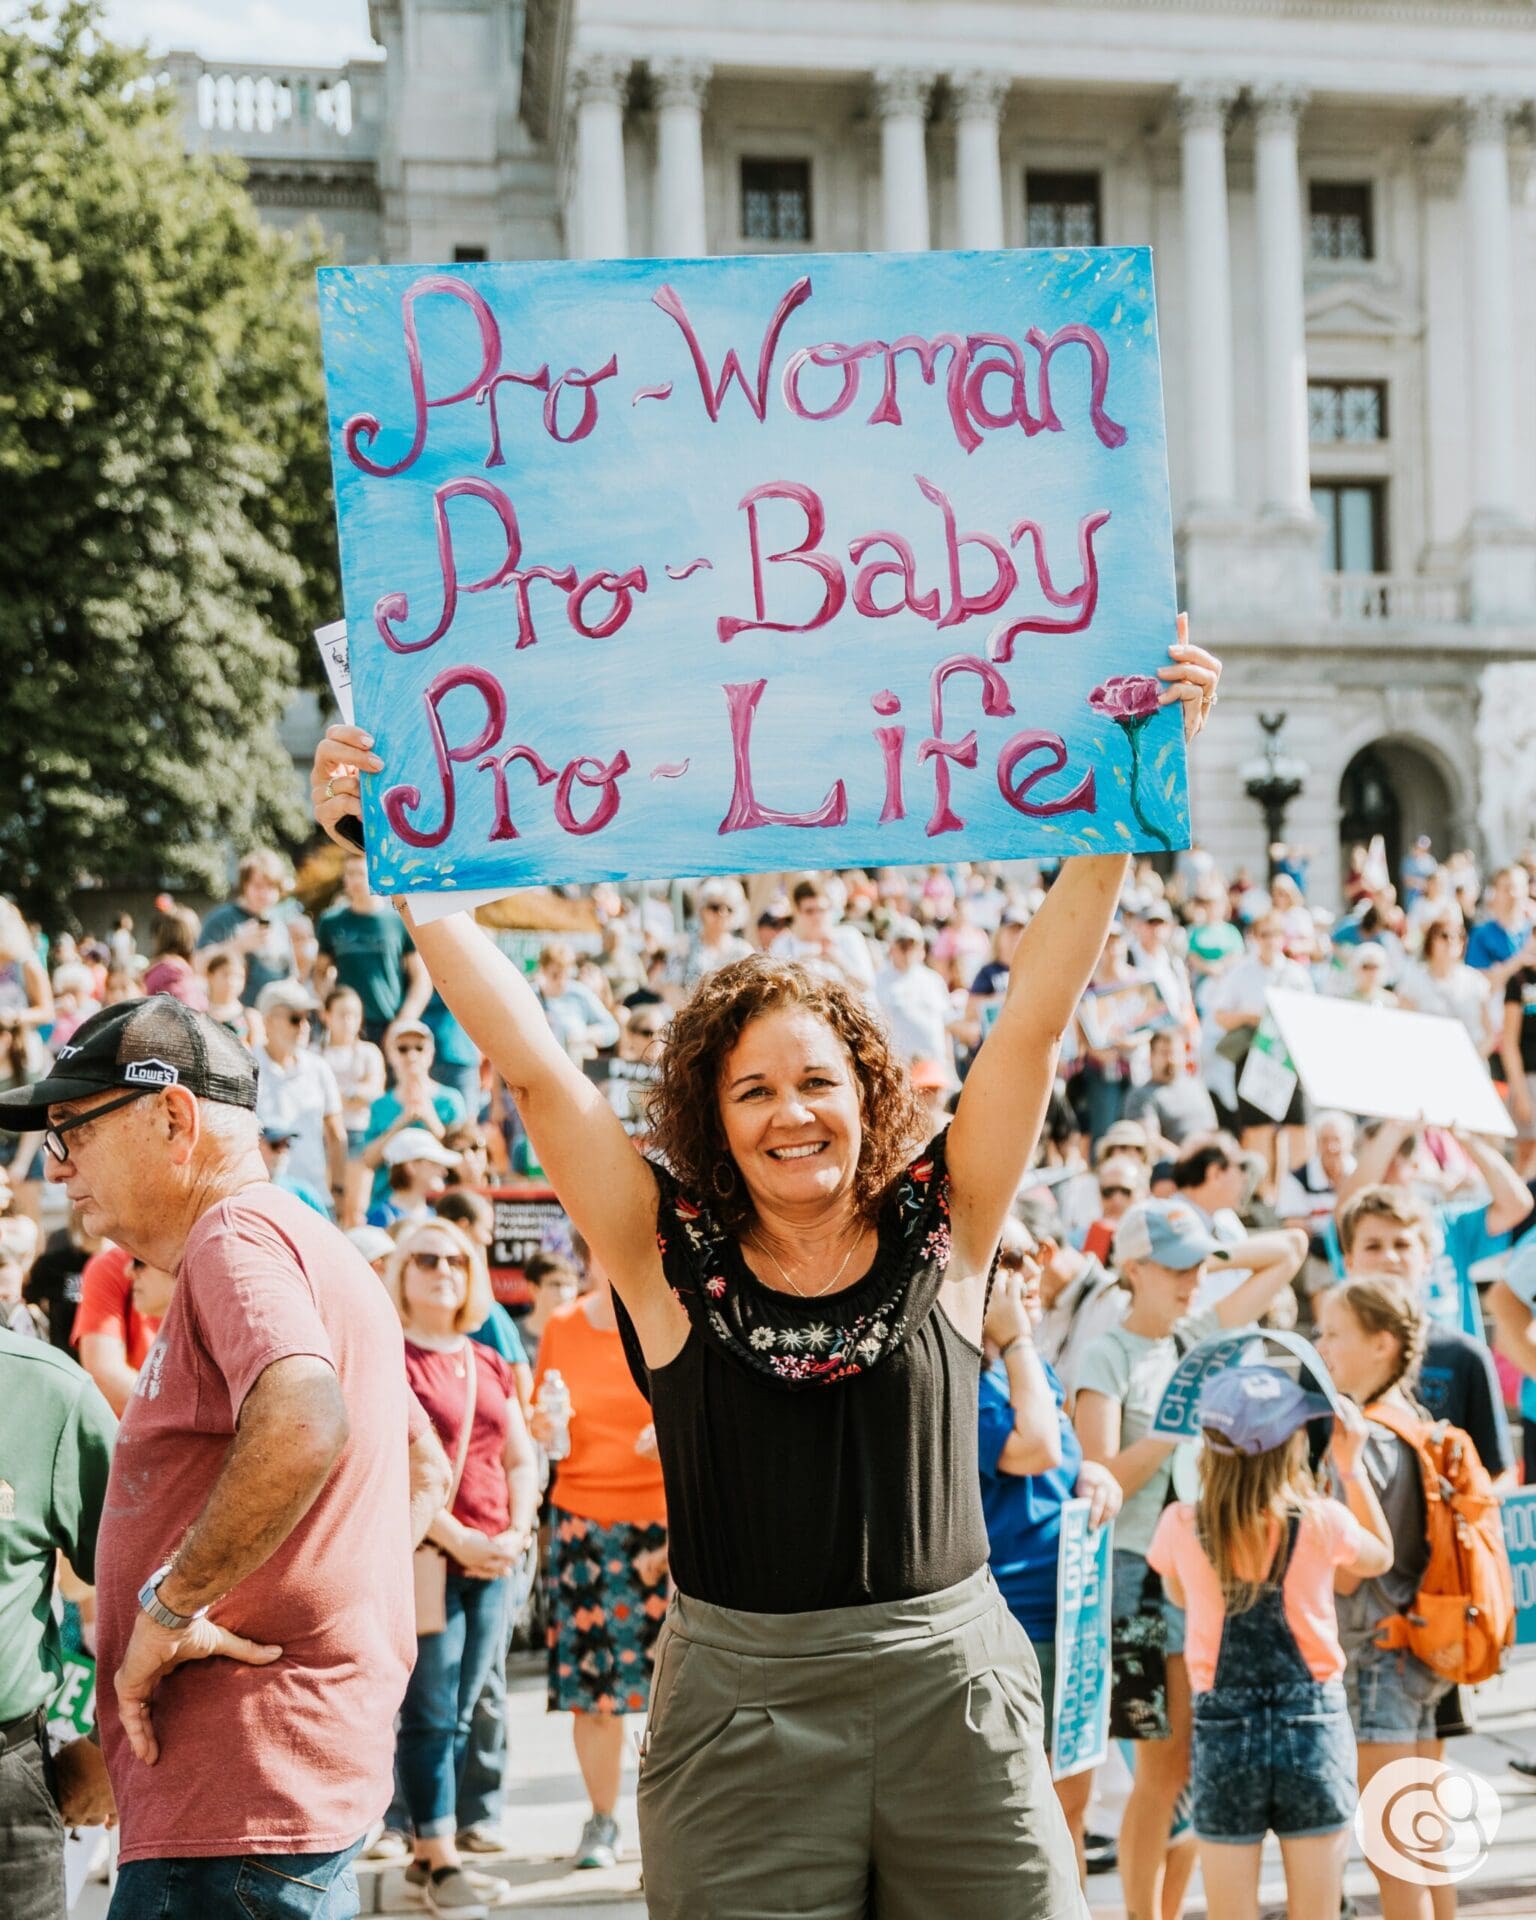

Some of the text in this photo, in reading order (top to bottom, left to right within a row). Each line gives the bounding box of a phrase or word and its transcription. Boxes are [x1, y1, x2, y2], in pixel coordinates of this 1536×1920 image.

[131, 1065, 173, 1082] LOWE'S
[1065, 1515, 1084, 1612] LOVE
[1081, 1534, 1099, 1606] LIFE
